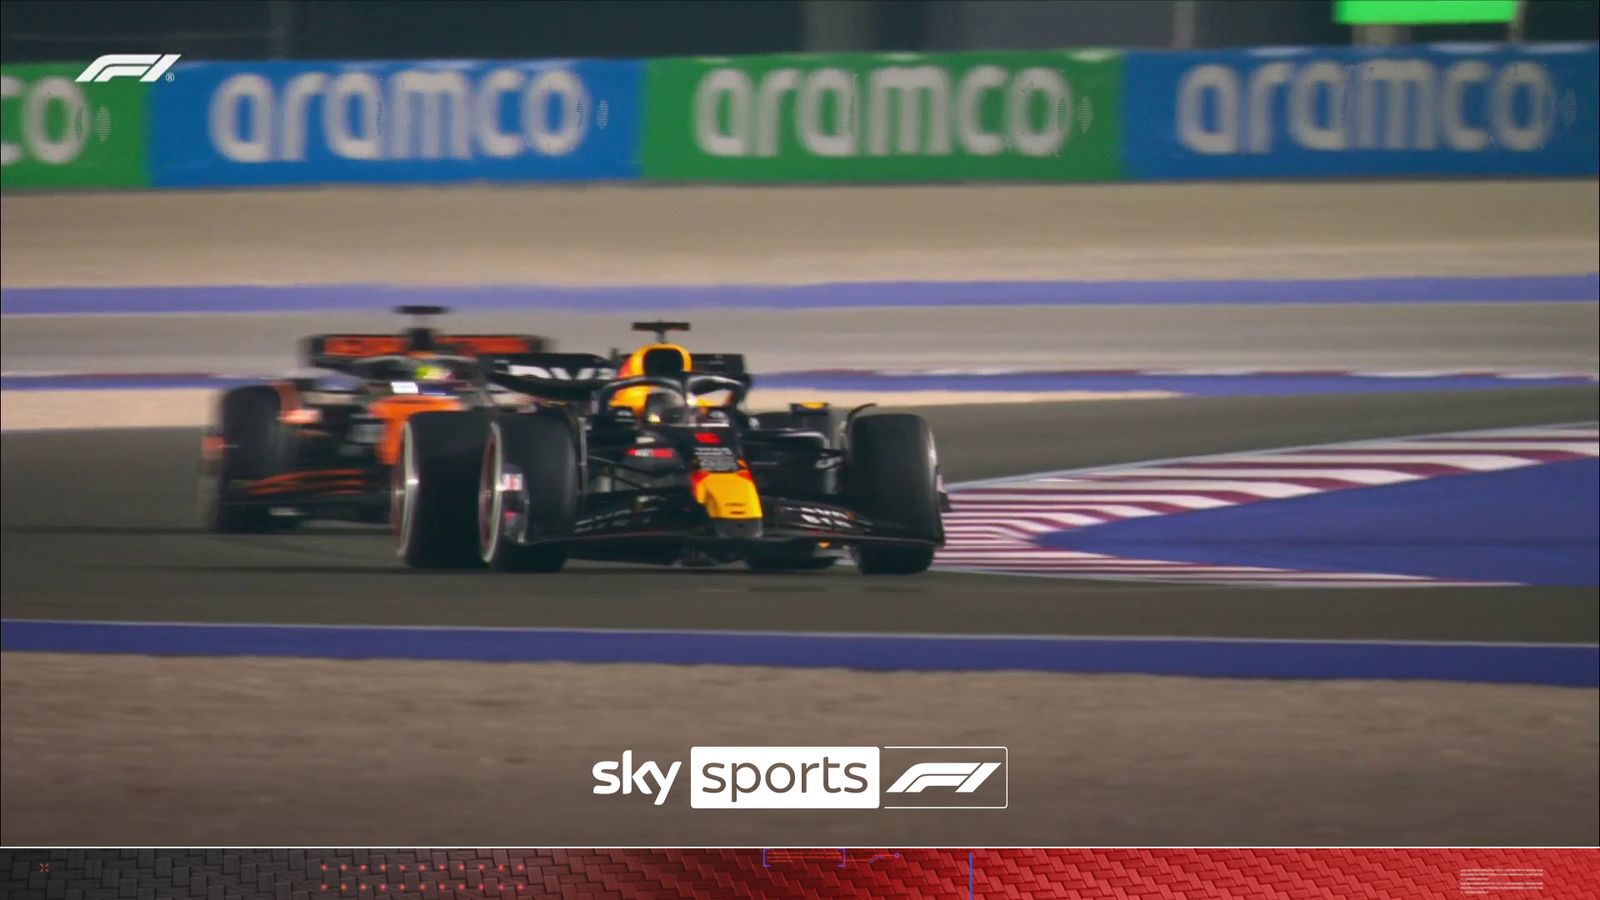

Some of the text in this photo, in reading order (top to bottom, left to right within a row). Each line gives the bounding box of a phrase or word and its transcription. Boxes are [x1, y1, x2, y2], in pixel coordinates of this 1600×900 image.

[210, 70, 588, 163] aramco
[694, 67, 1072, 156] aramco
[1176, 60, 1552, 154] aramco
